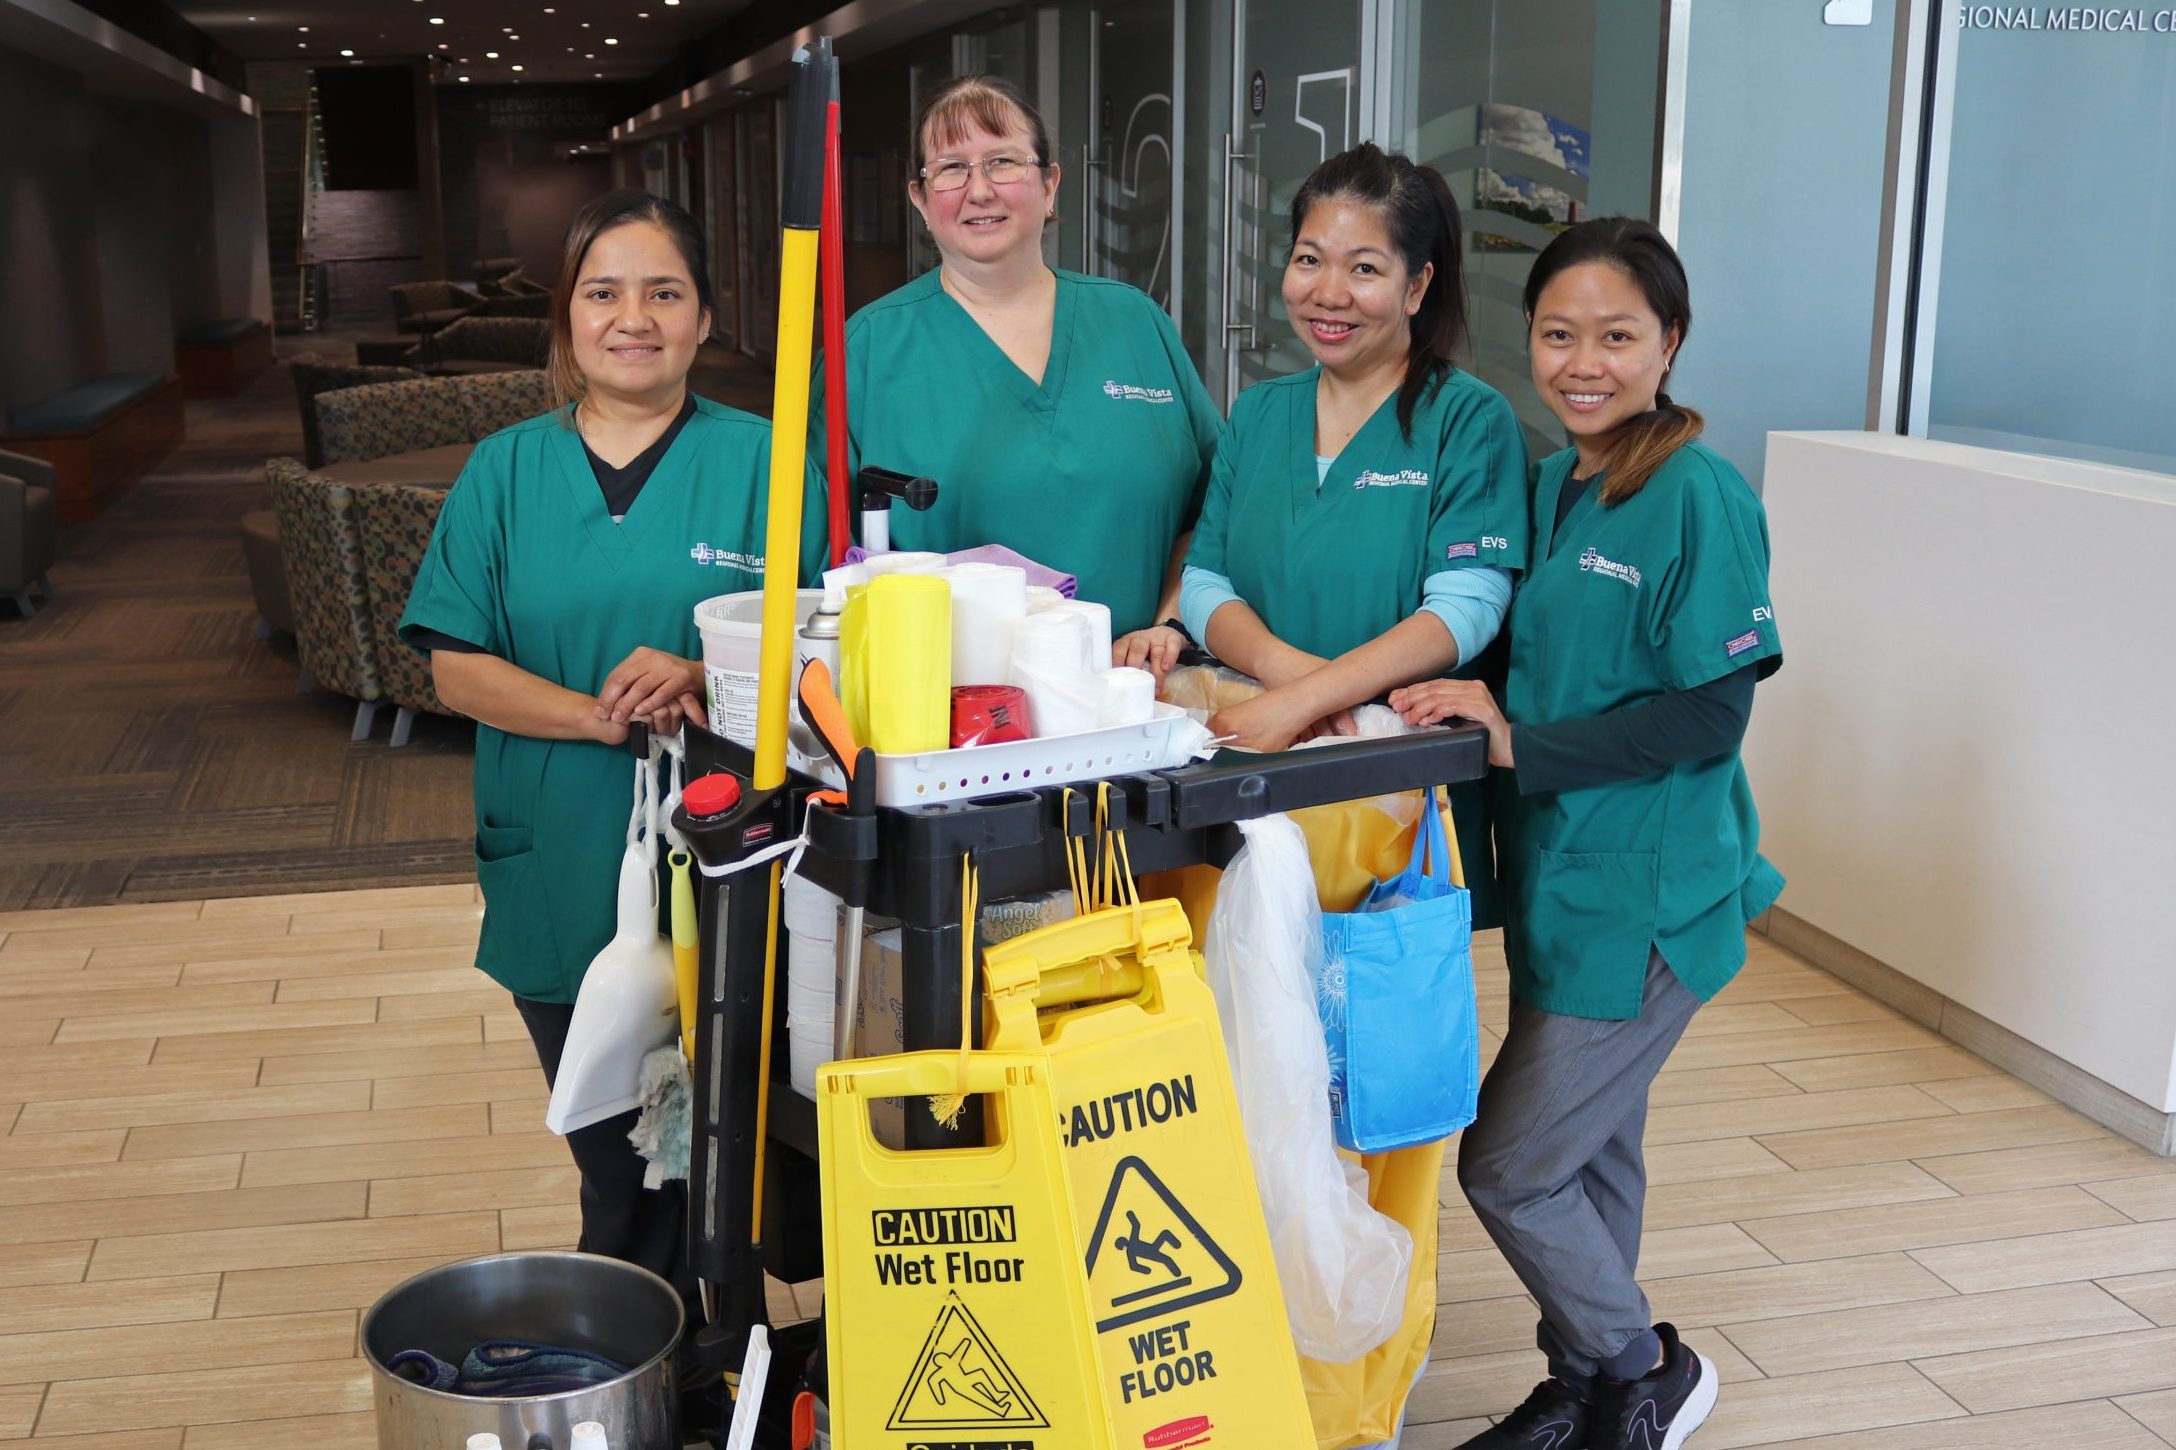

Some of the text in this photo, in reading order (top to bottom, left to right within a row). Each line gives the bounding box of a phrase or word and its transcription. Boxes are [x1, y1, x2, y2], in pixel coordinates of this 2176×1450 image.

[2047, 8, 2148, 32] MEDICAL
[1148, 388, 1172, 397] Vista
[1371, 469, 1428, 482] Buena Vista
[1481, 536, 1508, 549] EVS
[745, 554, 765, 566] Vist
[1595, 556, 1629, 574] Buena
[1752, 605, 1772, 621] EV
[713, 675, 722, 705] DRINK
[991, 902, 1041, 923] Angel
[1002, 920, 1036, 939] Soft
[874, 1208, 1014, 1244] CAUTION
[874, 1251, 1025, 1286] Wet Floor
[1128, 1320, 1191, 1365] WET
[1120, 1350, 1217, 1404] FLOOR
